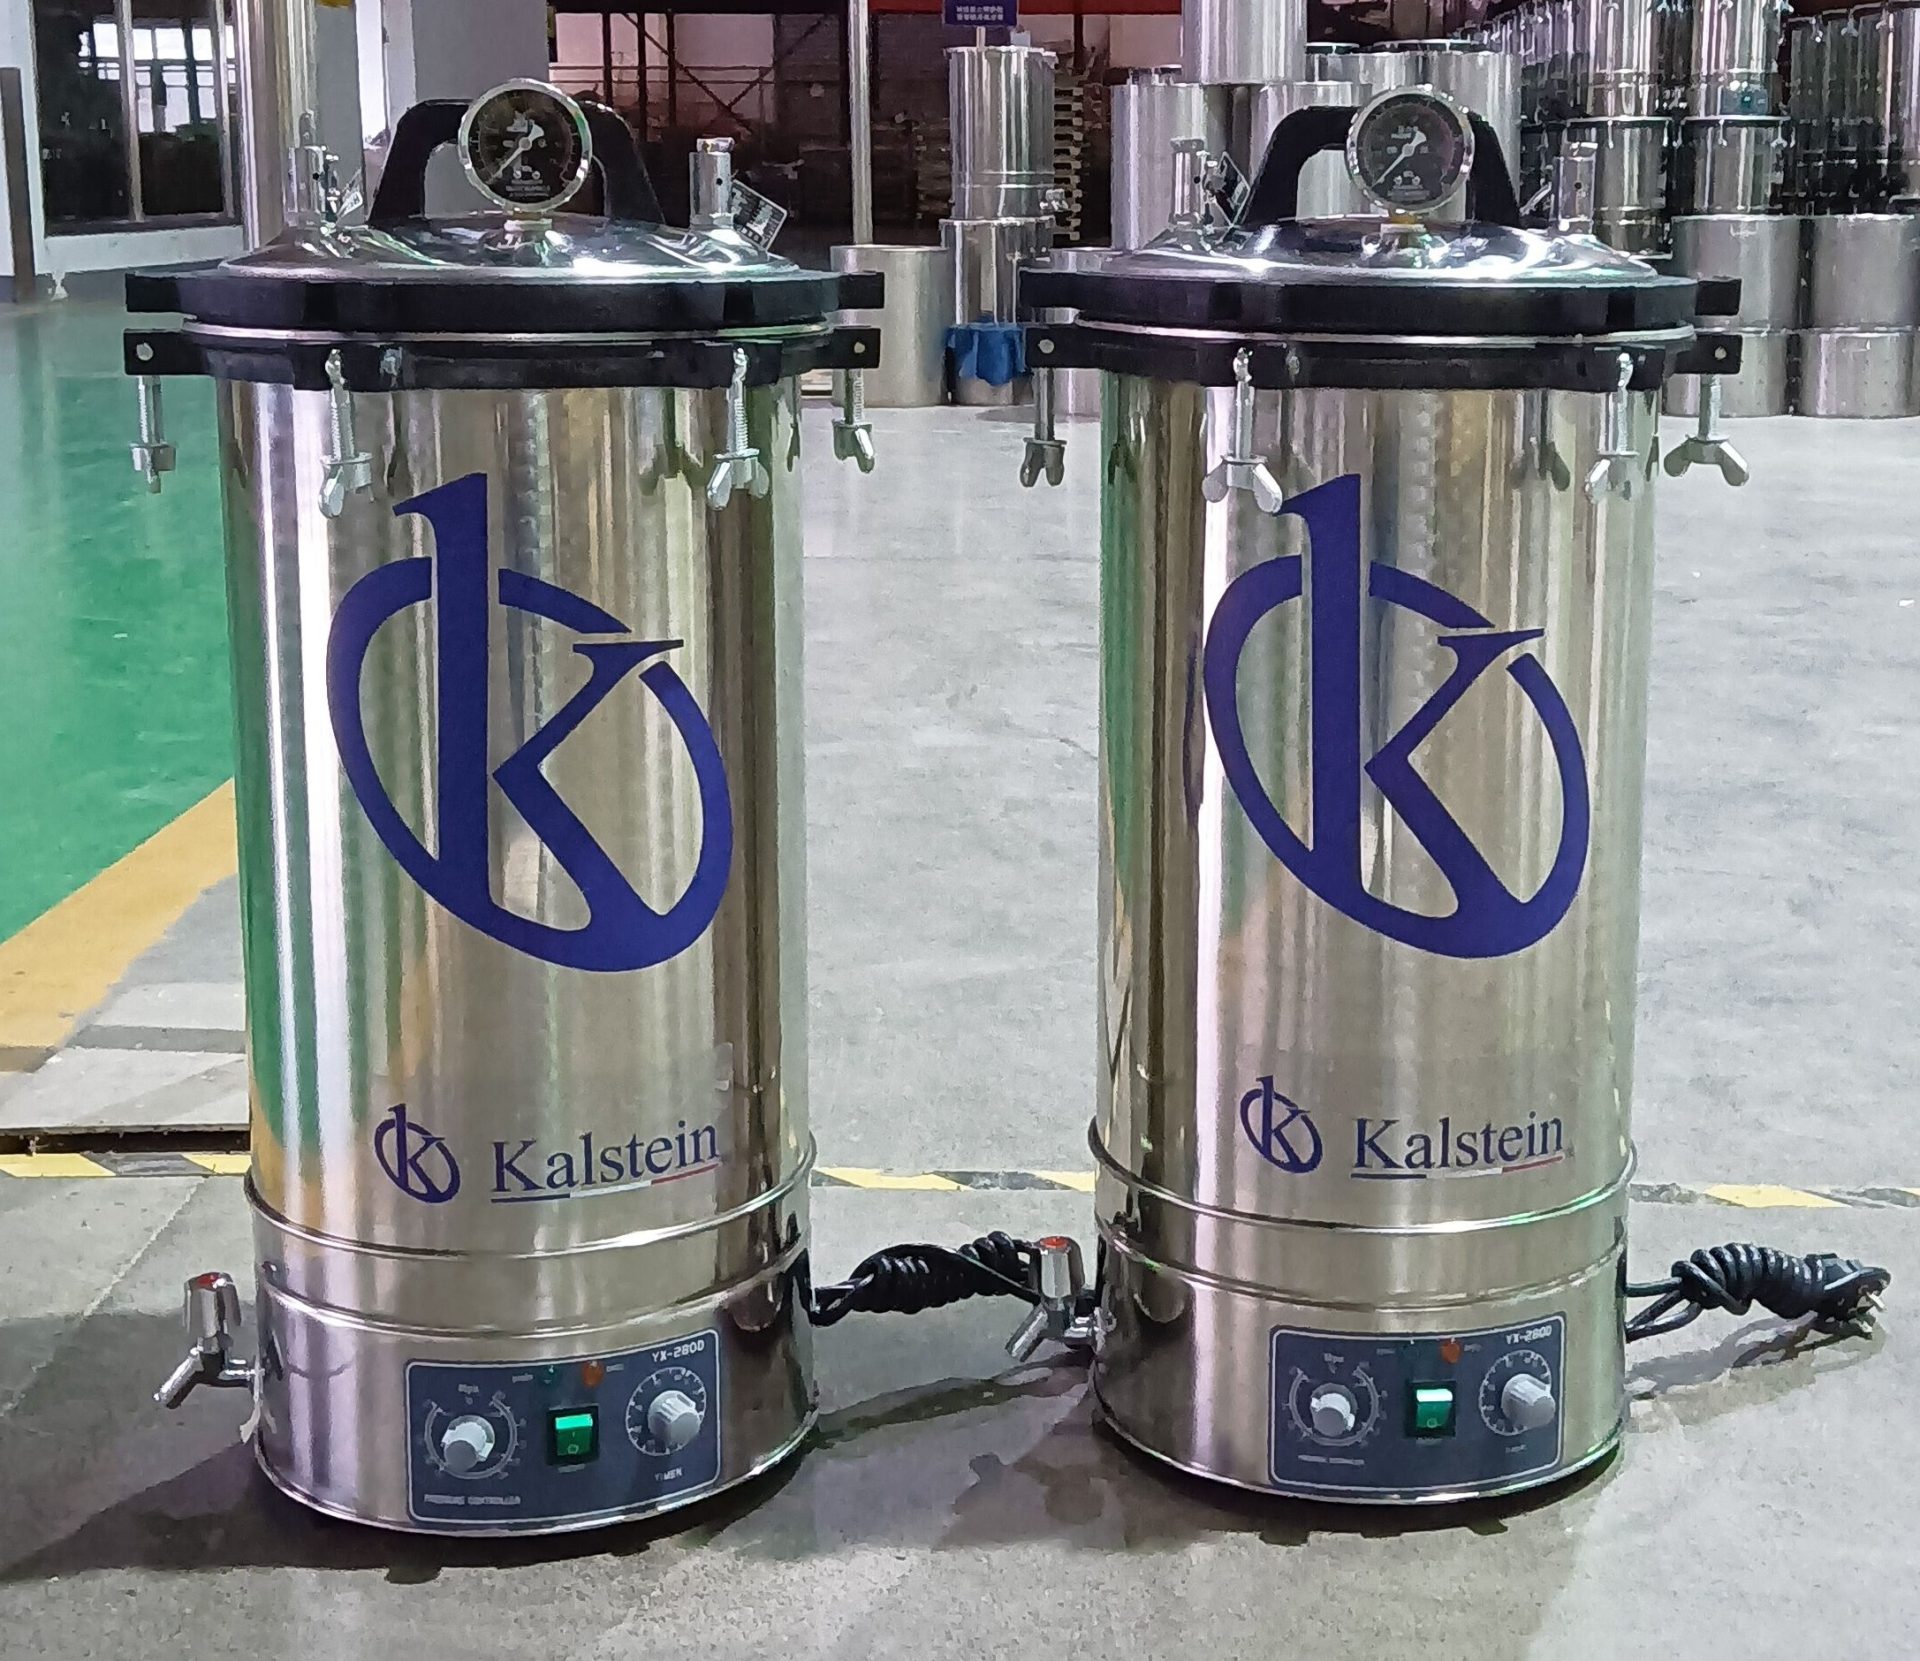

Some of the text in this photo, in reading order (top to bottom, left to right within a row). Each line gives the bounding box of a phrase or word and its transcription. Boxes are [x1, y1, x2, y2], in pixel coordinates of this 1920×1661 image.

[491, 1120, 720, 1193] Kalstein
[1352, 1111, 1564, 1170] Kalstein
[652, 1339, 705, 1363] YX-280D
